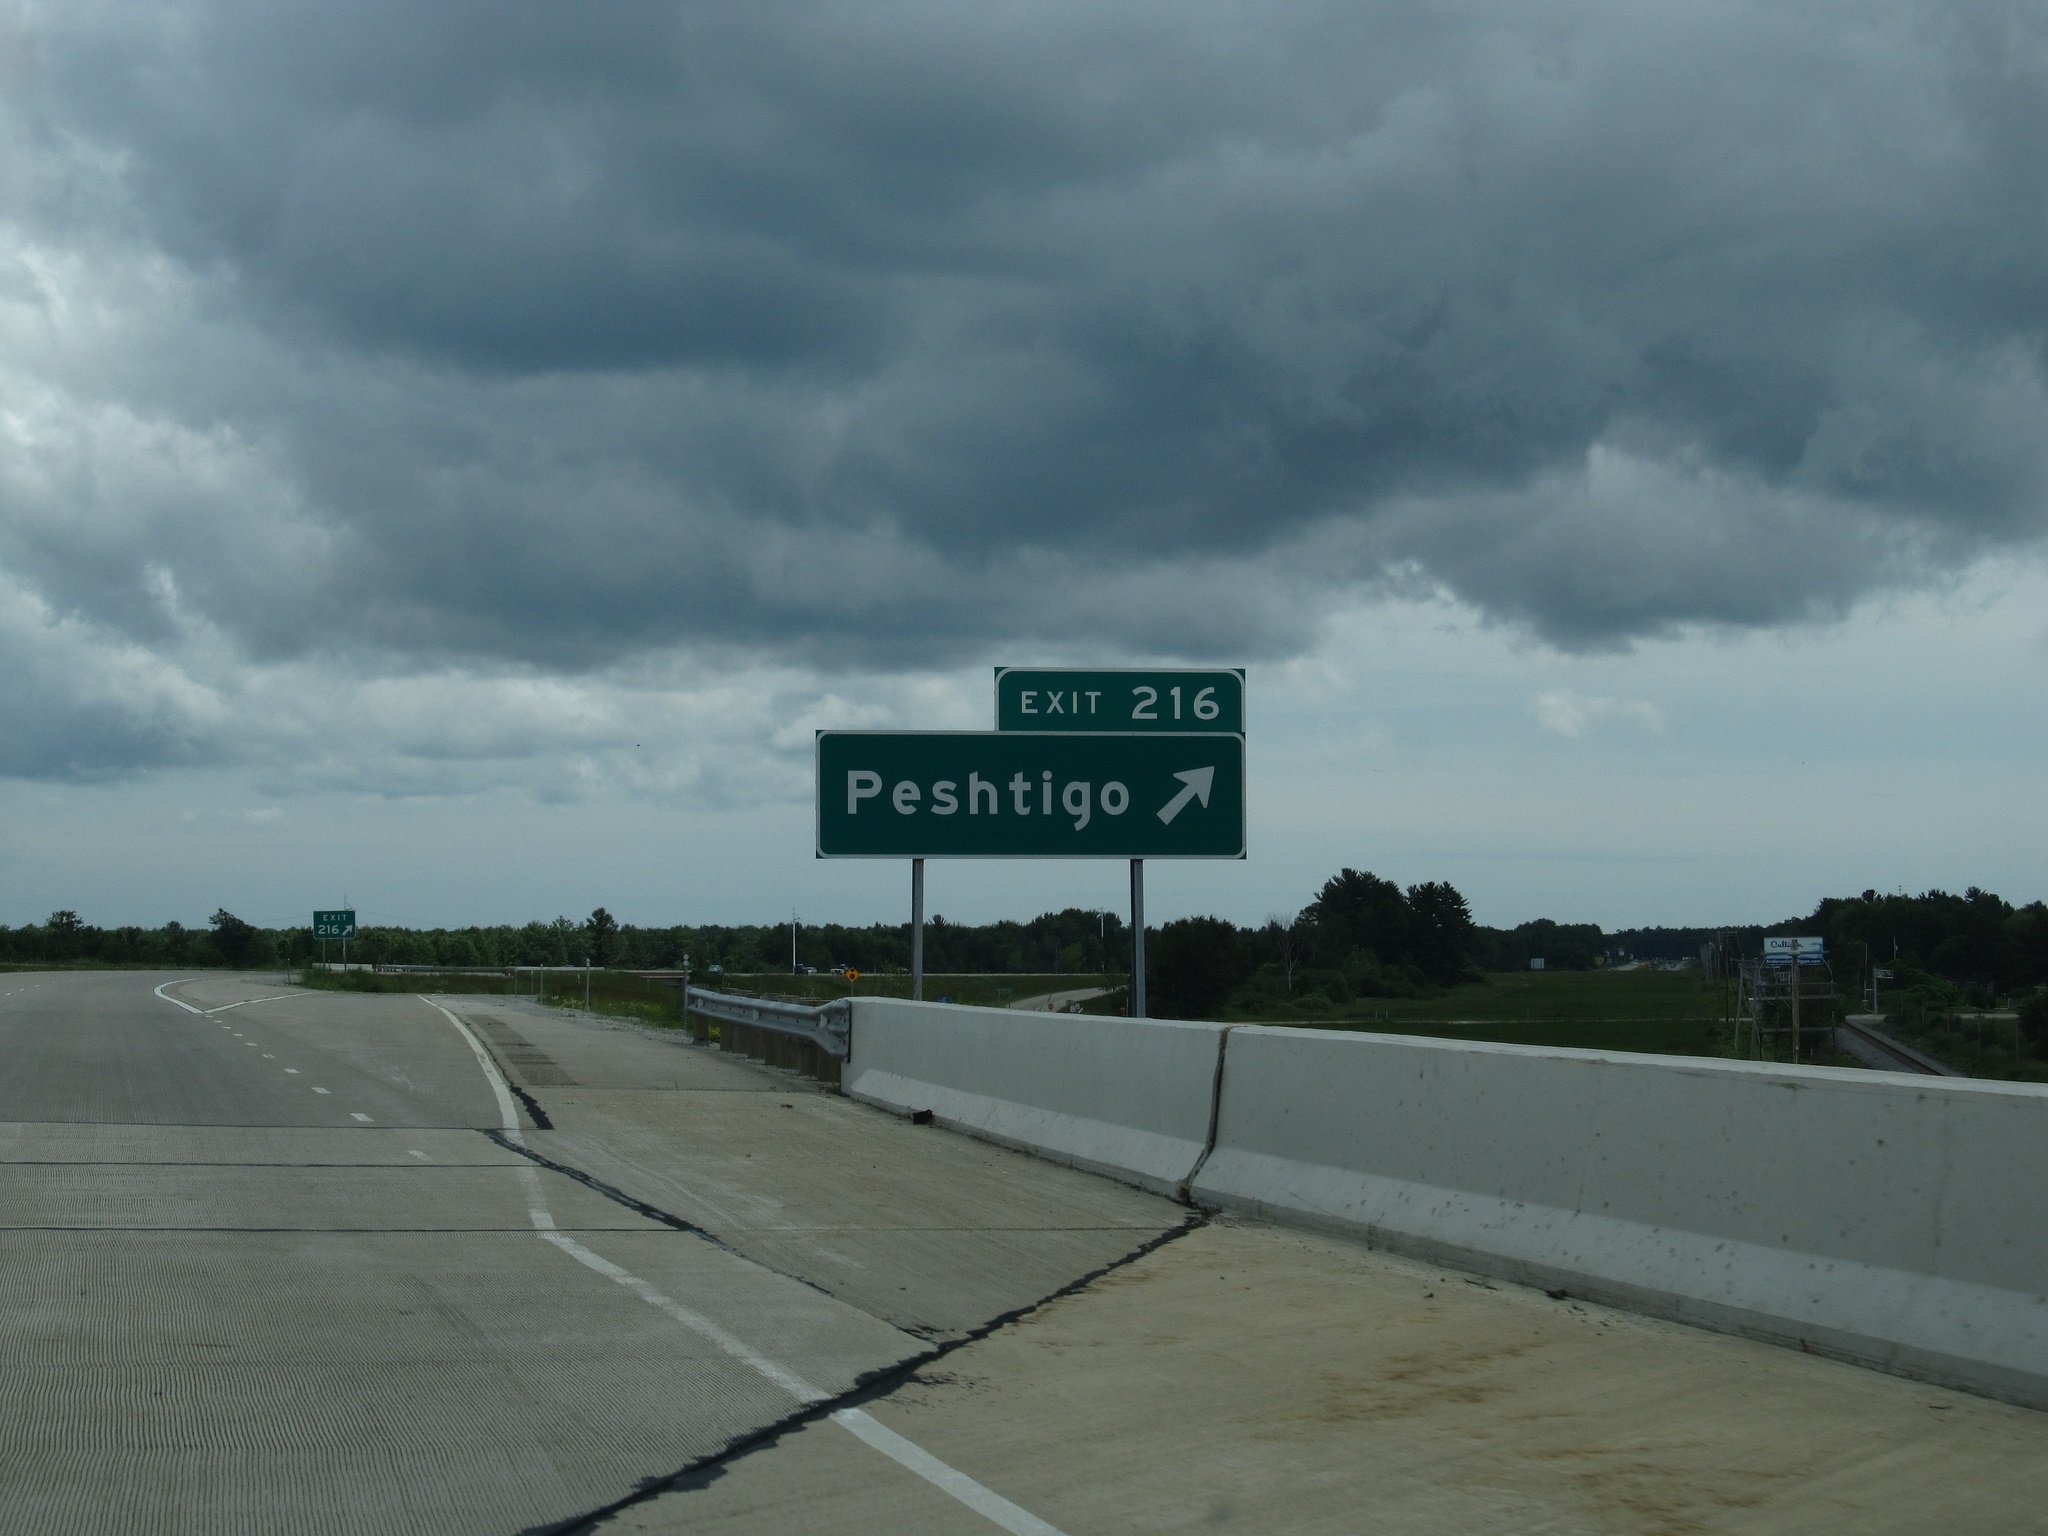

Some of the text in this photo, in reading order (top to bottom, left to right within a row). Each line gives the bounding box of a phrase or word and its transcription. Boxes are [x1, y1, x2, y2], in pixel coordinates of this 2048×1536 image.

[1021, 685, 1220, 720] EXIT 216
[847, 769, 1130, 831] Peshtigo
[318, 924, 340, 935] 216
